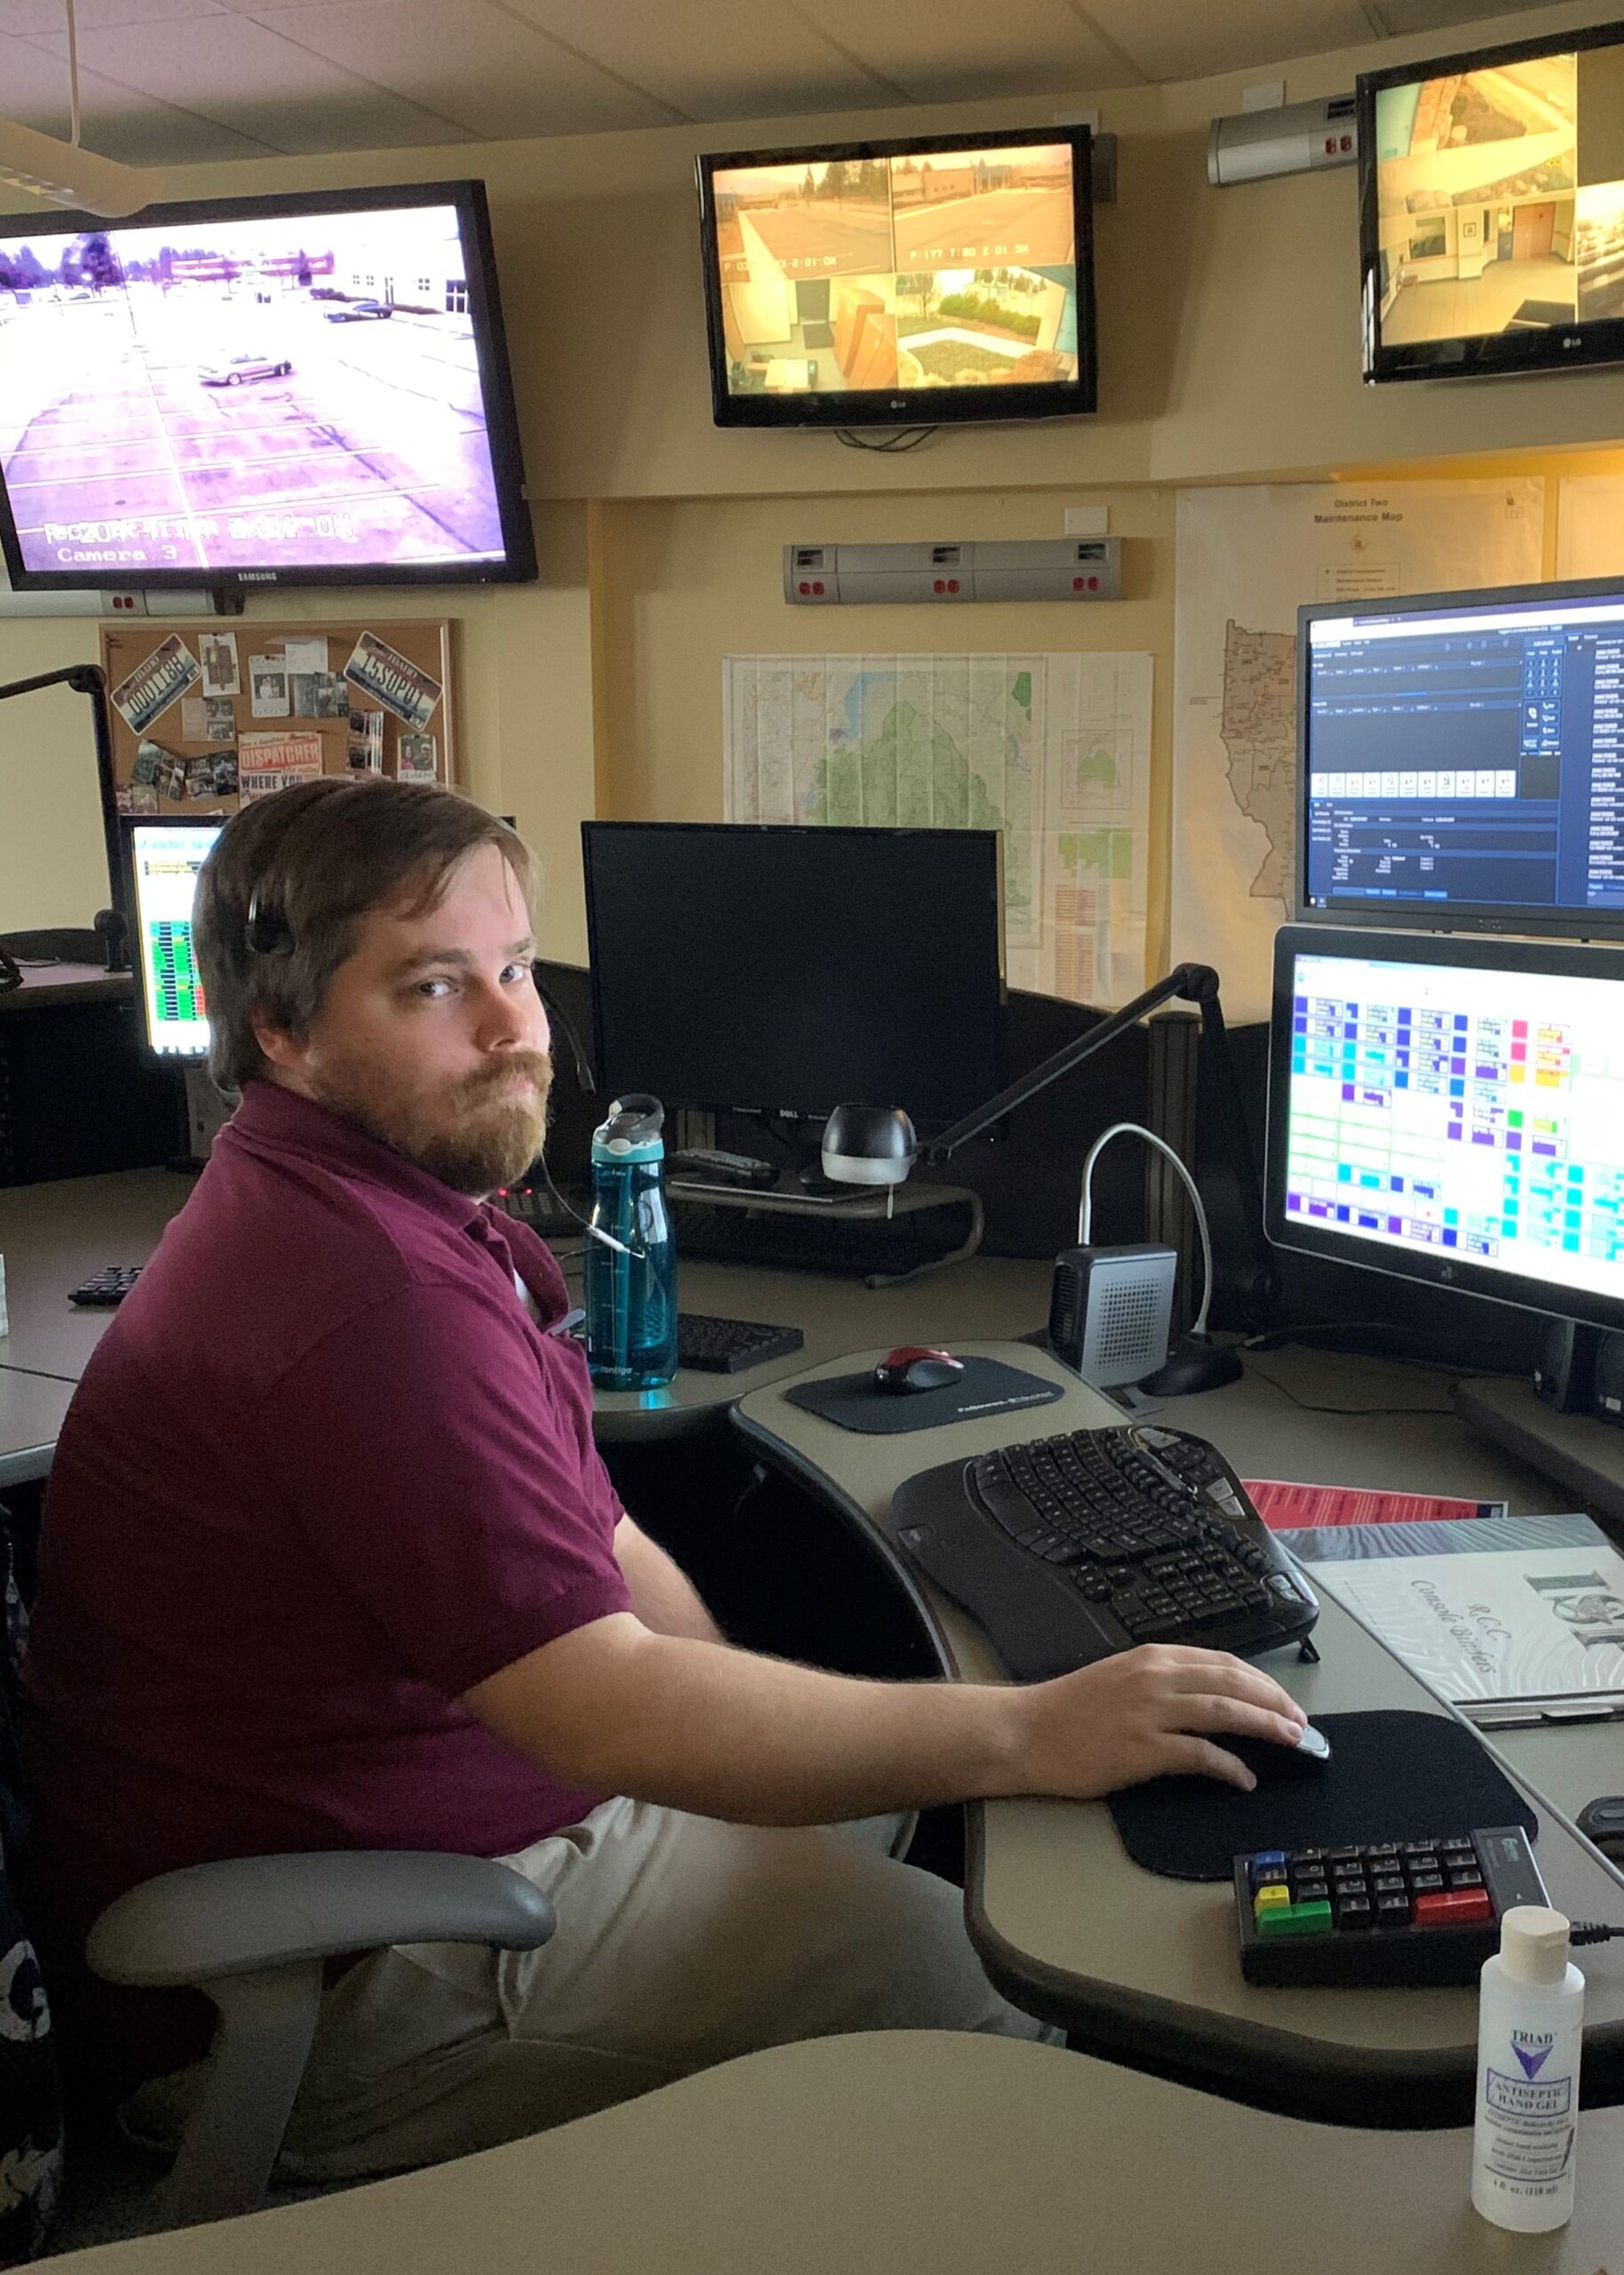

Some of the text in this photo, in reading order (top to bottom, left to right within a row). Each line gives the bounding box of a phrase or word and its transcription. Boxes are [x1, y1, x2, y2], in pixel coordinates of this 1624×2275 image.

[1334, 498, 1389, 508] District Two
[1314, 512, 1404, 523] Maintenance Map
[57, 544, 179, 563] Camera 3
[237, 571, 277, 582] SAMSUNG
[241, 743, 320, 770] DISPATCHER
[241, 775, 278, 791] WHERE
[1511, 2030, 1553, 2045] TRIAD
[1495, 2082, 1564, 2098] ANTISEPTIC
[1498, 2094, 1558, 2111] HAND GEL
